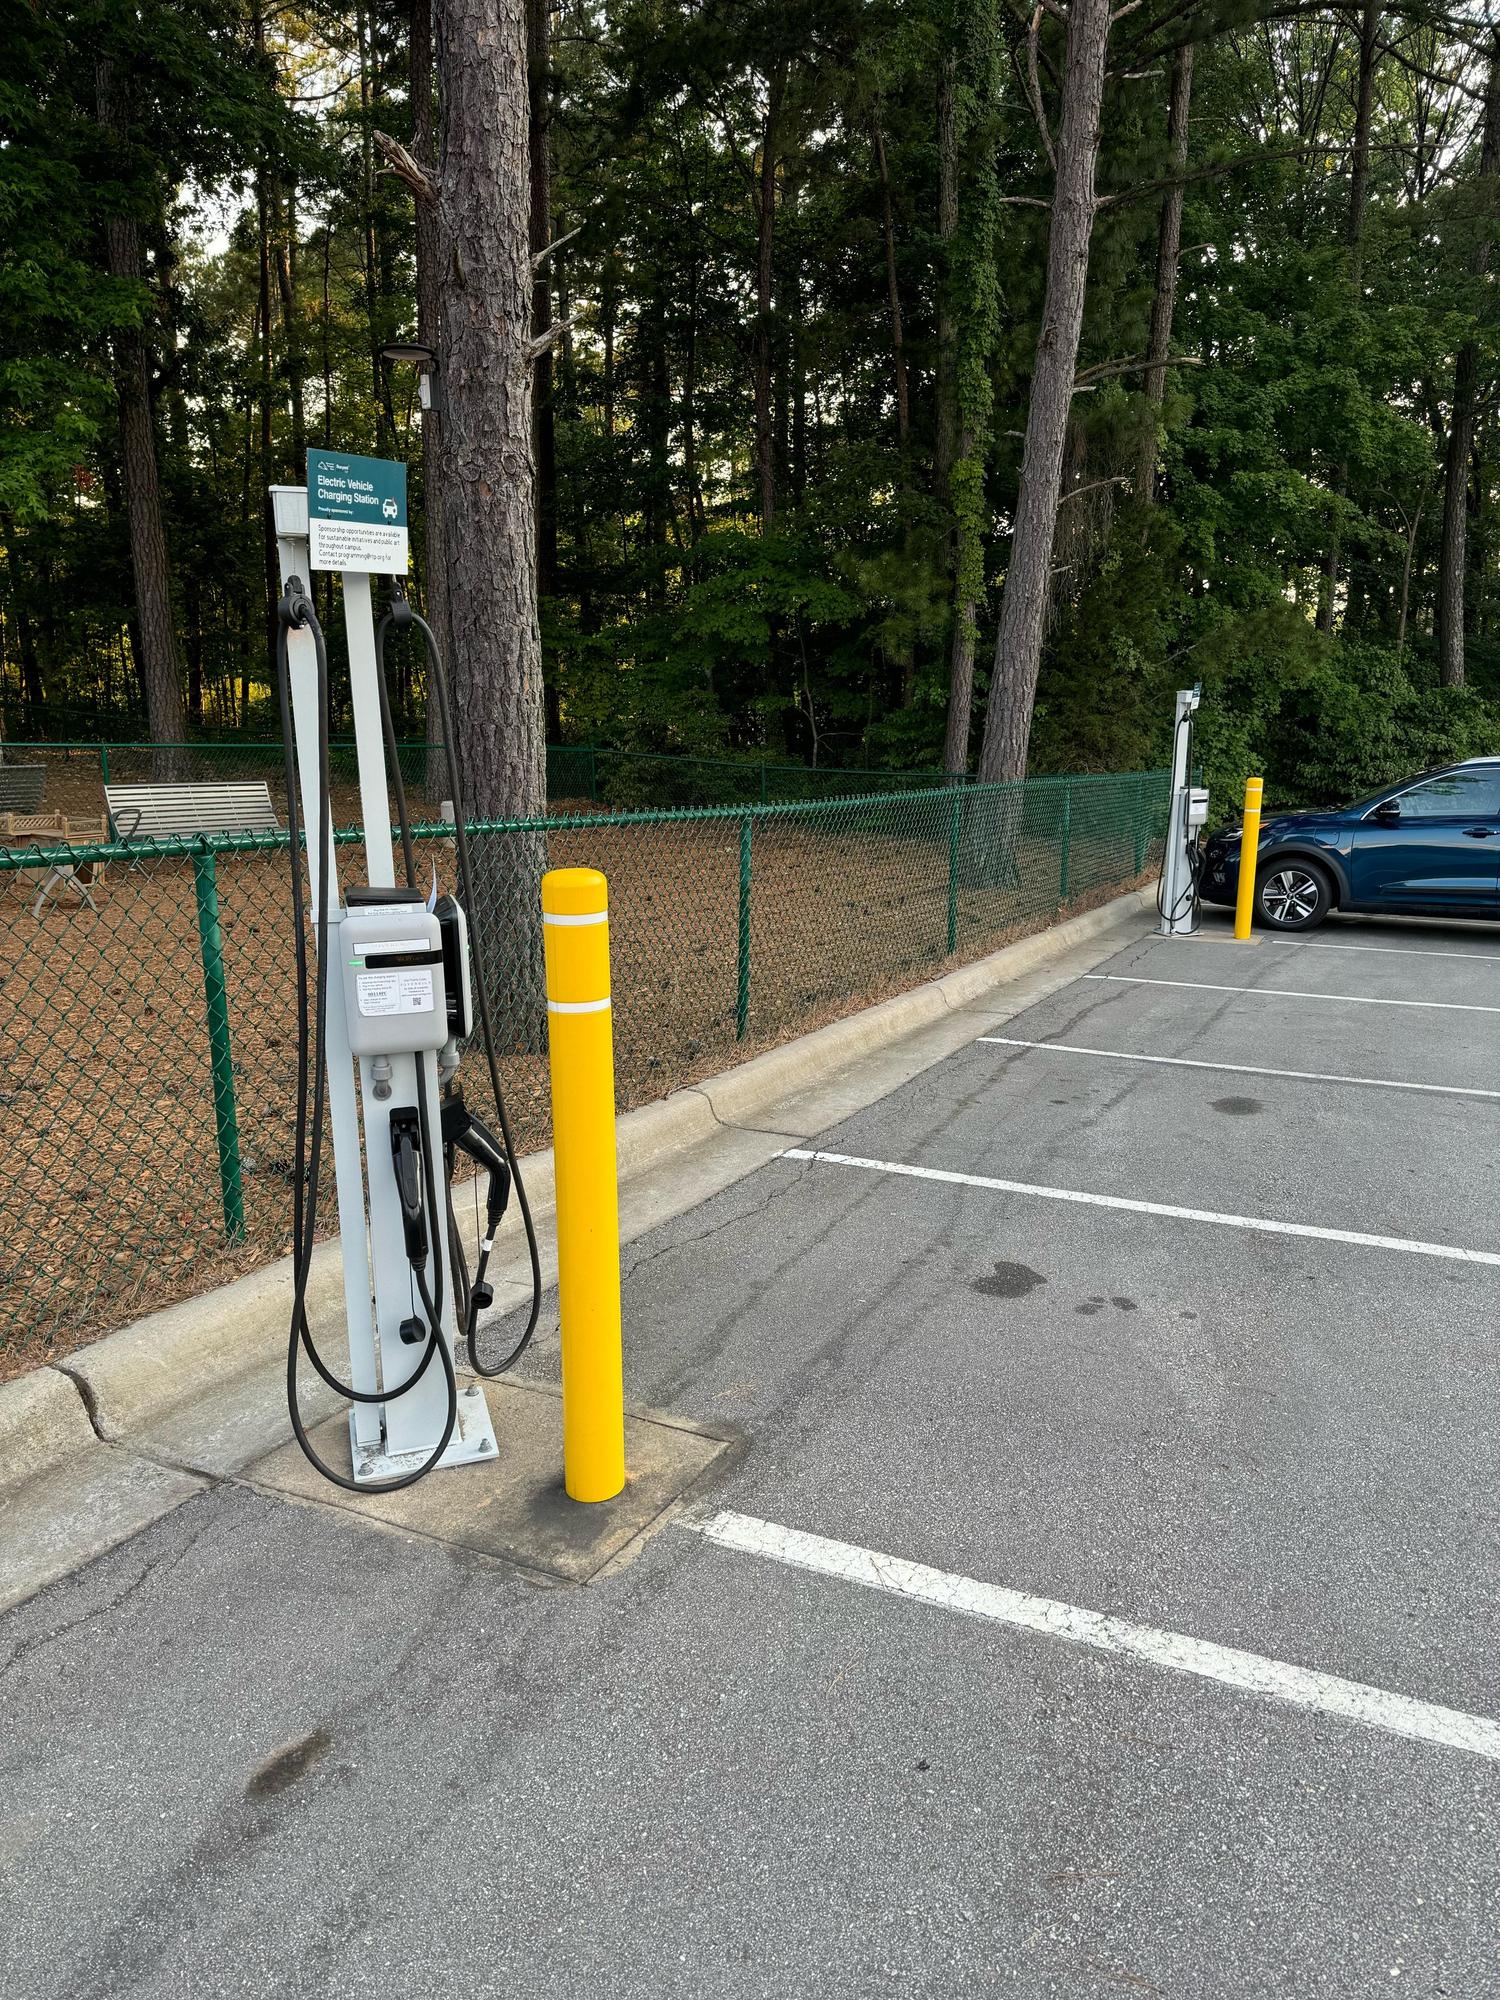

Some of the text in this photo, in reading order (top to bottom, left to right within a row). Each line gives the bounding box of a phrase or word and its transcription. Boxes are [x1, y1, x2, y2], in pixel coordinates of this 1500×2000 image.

[318, 475, 374, 492] Electric Vehicle
[318, 488, 379, 505] Charging Station
[318, 524, 345, 534] Sponsorship
[346, 528, 374, 537] opportunities
[318, 533, 326, 541] for
[327, 534, 352, 542] sustainable
[318, 541, 343, 551] throughout
[318, 549, 338, 558] Contact
[319, 558, 331, 566] more
